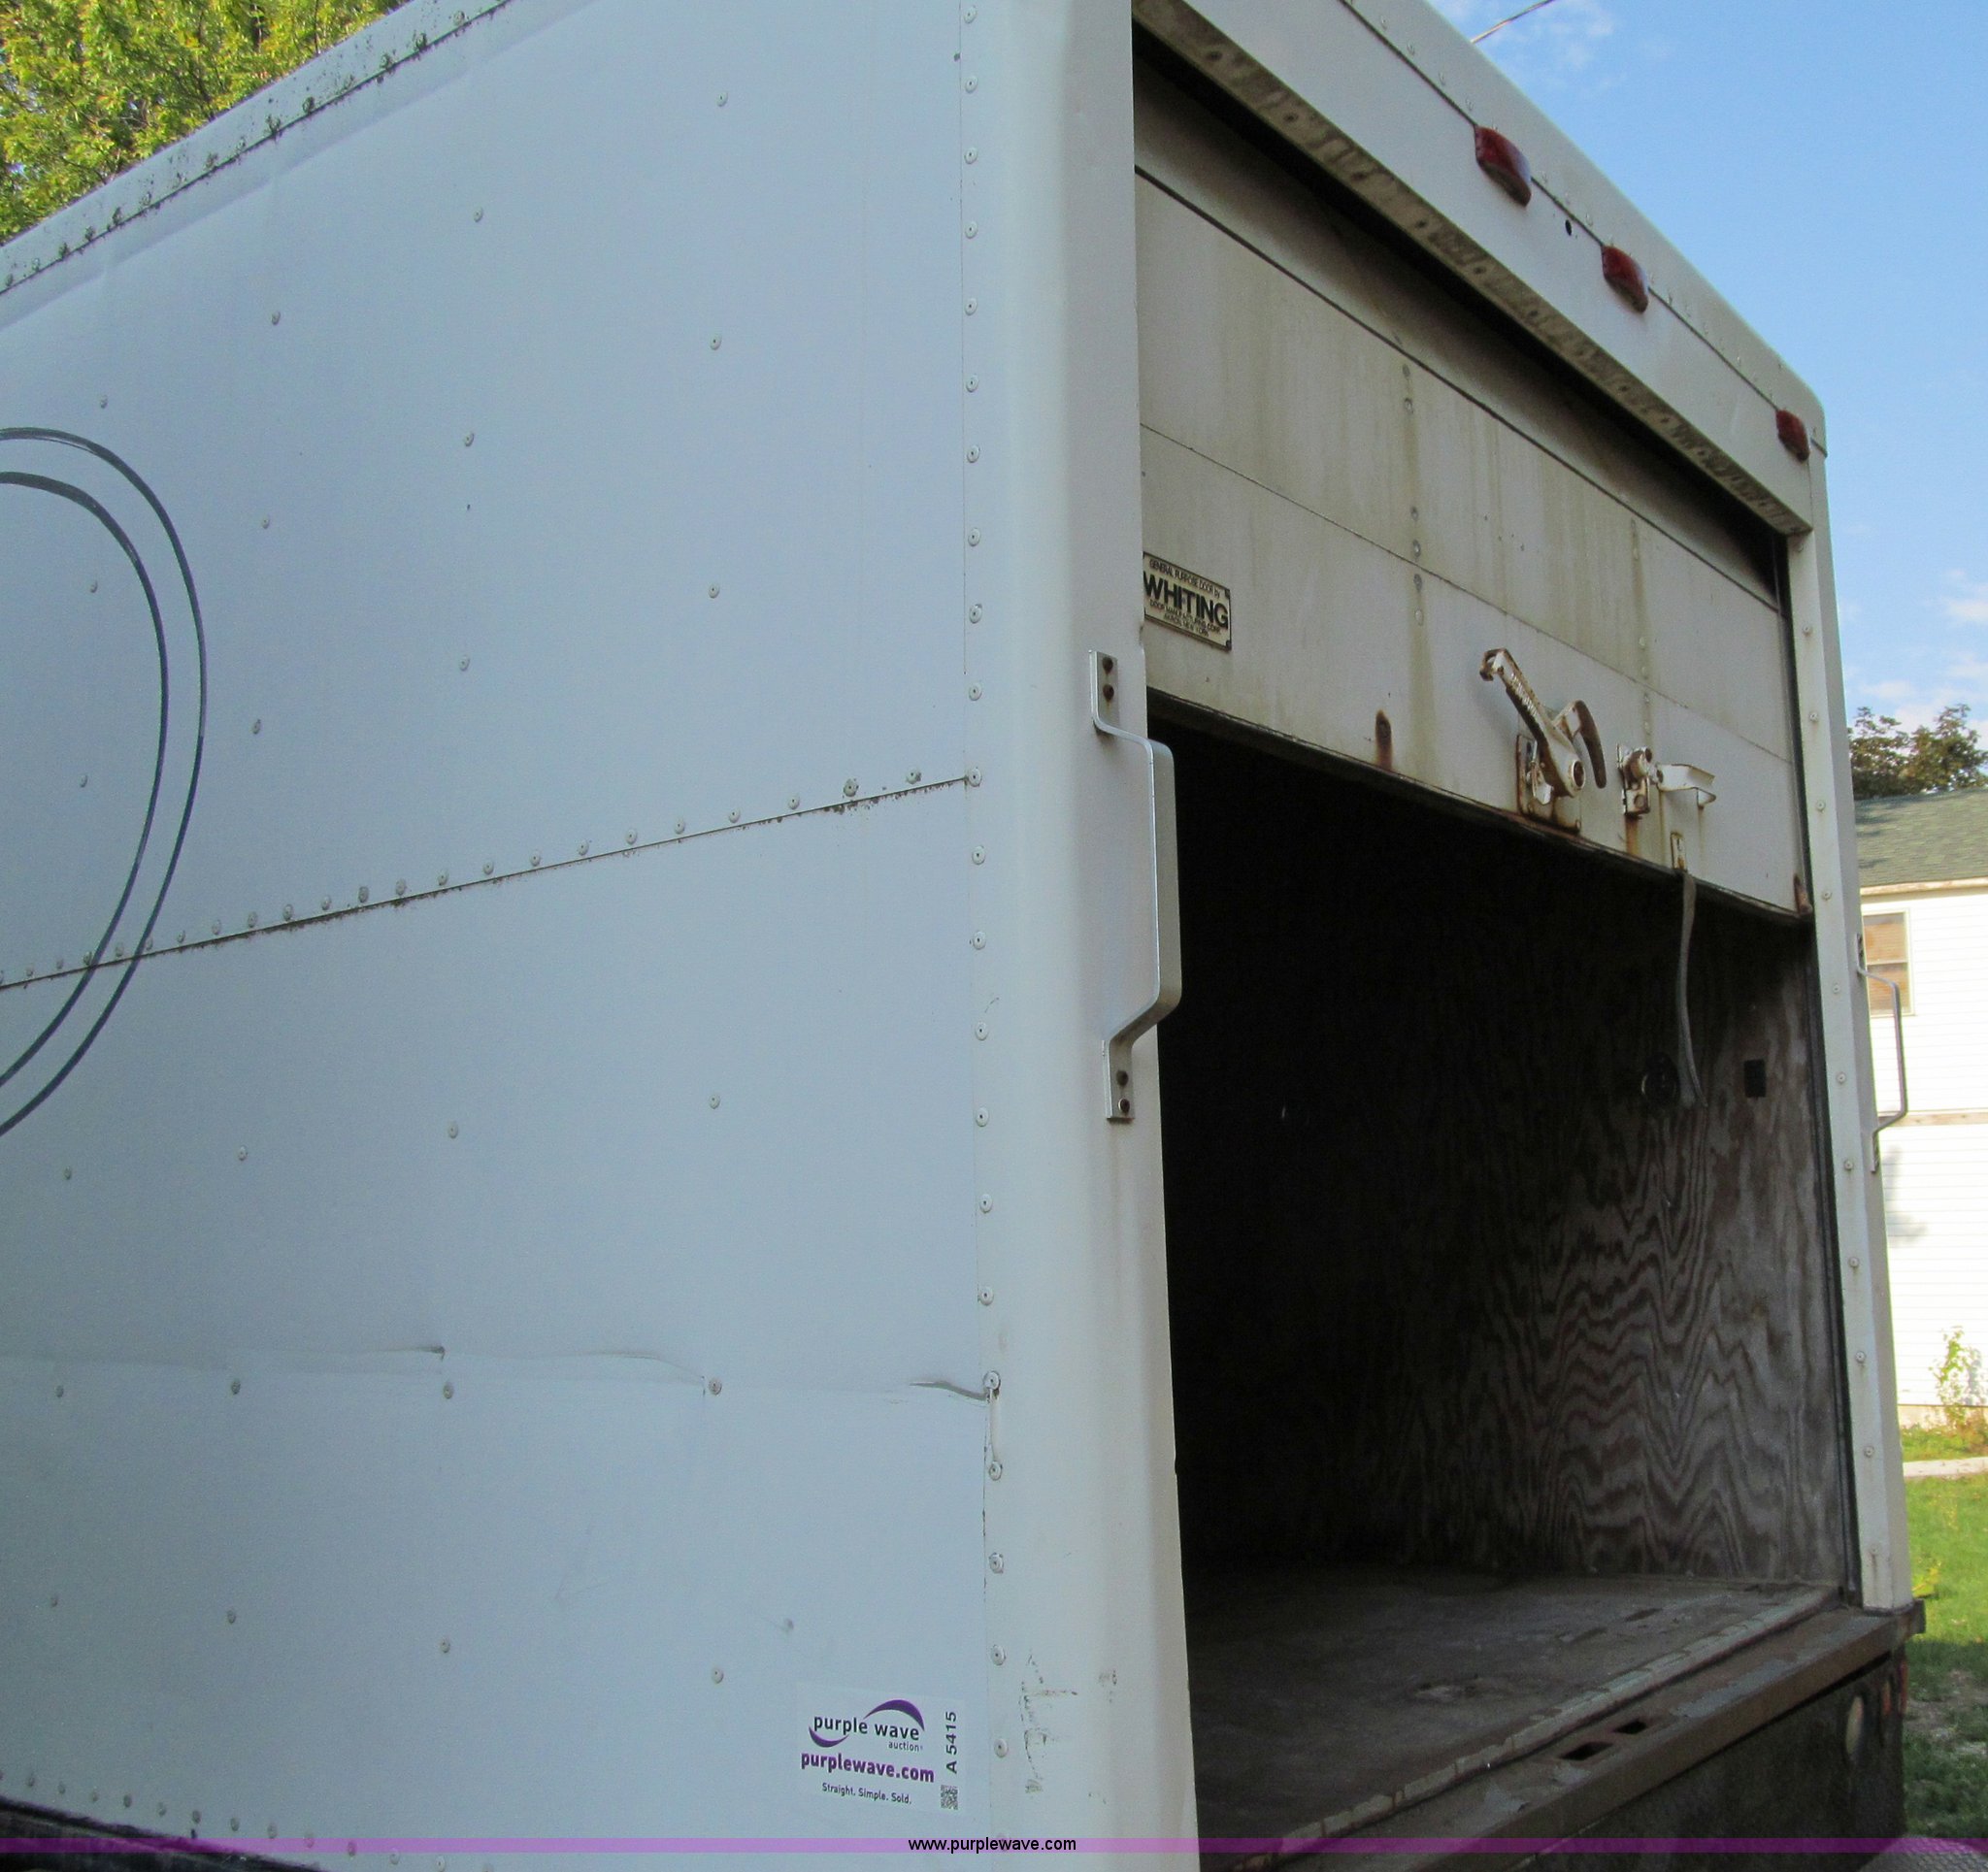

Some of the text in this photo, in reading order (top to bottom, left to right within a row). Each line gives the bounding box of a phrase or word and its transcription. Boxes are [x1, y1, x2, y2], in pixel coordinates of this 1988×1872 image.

[1143, 571, 1228, 629] WHITING
[813, 1716, 919, 1740] purple wave
[945, 1711, 957, 1774] A 5415
[801, 1753, 935, 1783] purplewave.com
[822, 1782, 911, 1805] Straight. Simple. Sold.
